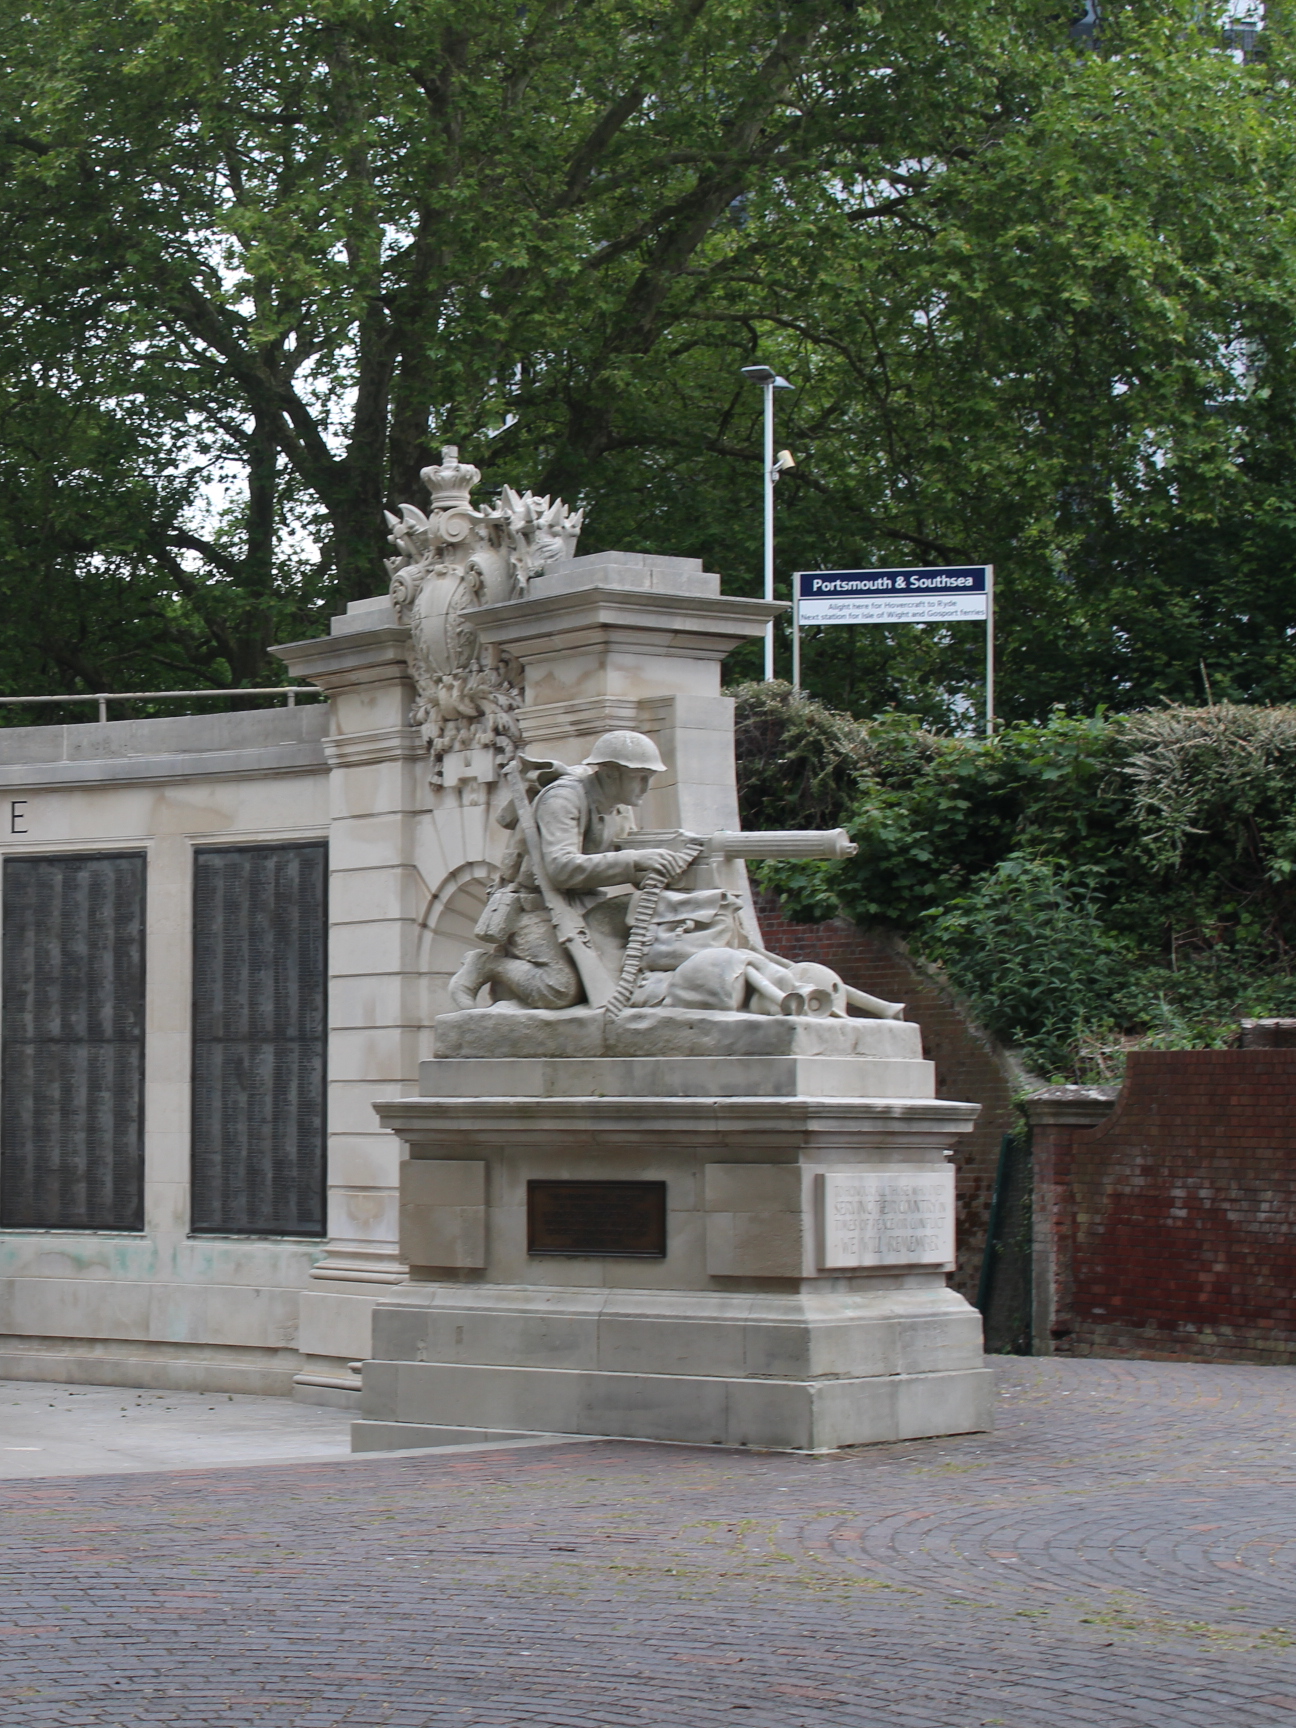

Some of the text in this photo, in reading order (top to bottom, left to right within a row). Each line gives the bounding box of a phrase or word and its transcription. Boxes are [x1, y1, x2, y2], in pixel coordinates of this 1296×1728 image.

[813, 575, 974, 592] Portsmouth & Southsea
[828, 602, 851, 612] Alight
[852, 602, 870, 610] here
[884, 601, 926, 609] Hovercraft
[937, 599, 957, 609] Ryde
[801, 608, 986, 621] Next station for Isle of Wight and Gosport ferries
